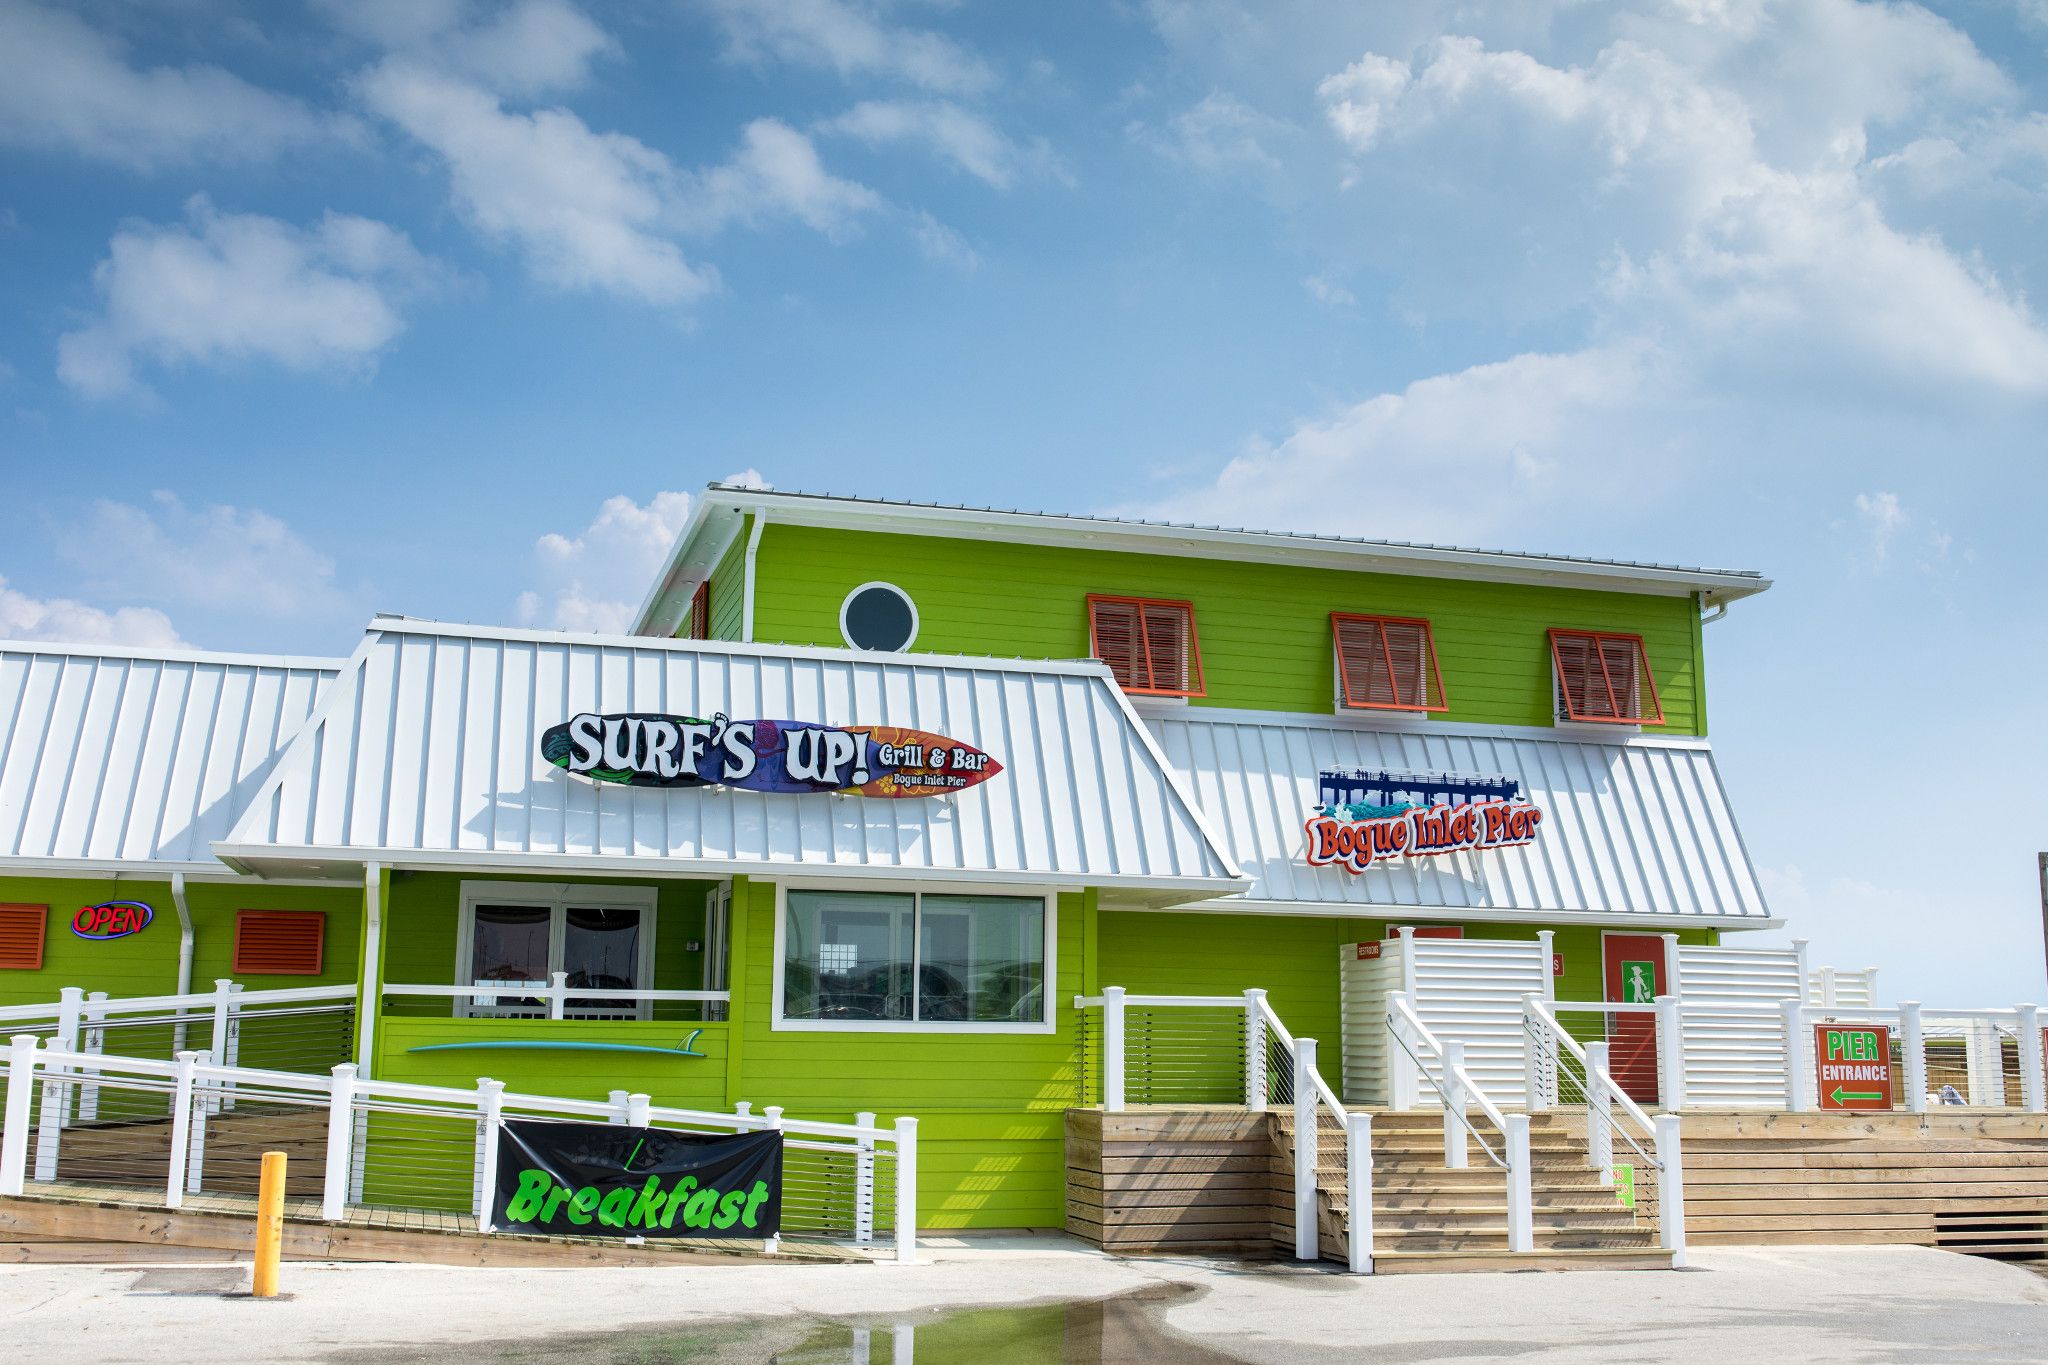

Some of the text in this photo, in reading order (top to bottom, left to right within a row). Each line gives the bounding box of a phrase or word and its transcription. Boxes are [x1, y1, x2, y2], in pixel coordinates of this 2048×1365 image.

[568, 713, 870, 784] SURF'S UP!
[879, 743, 988, 771] Grill & Bar
[893, 773, 966, 787] Bogue Inlet Pier
[1318, 804, 1541, 868] Bogue Inlet Pier
[73, 906, 146, 934] OPEN
[1826, 1030, 1879, 1061] PIER
[1822, 1065, 1888, 1081] ENTRANCE
[505, 1169, 769, 1229] Breakfast
